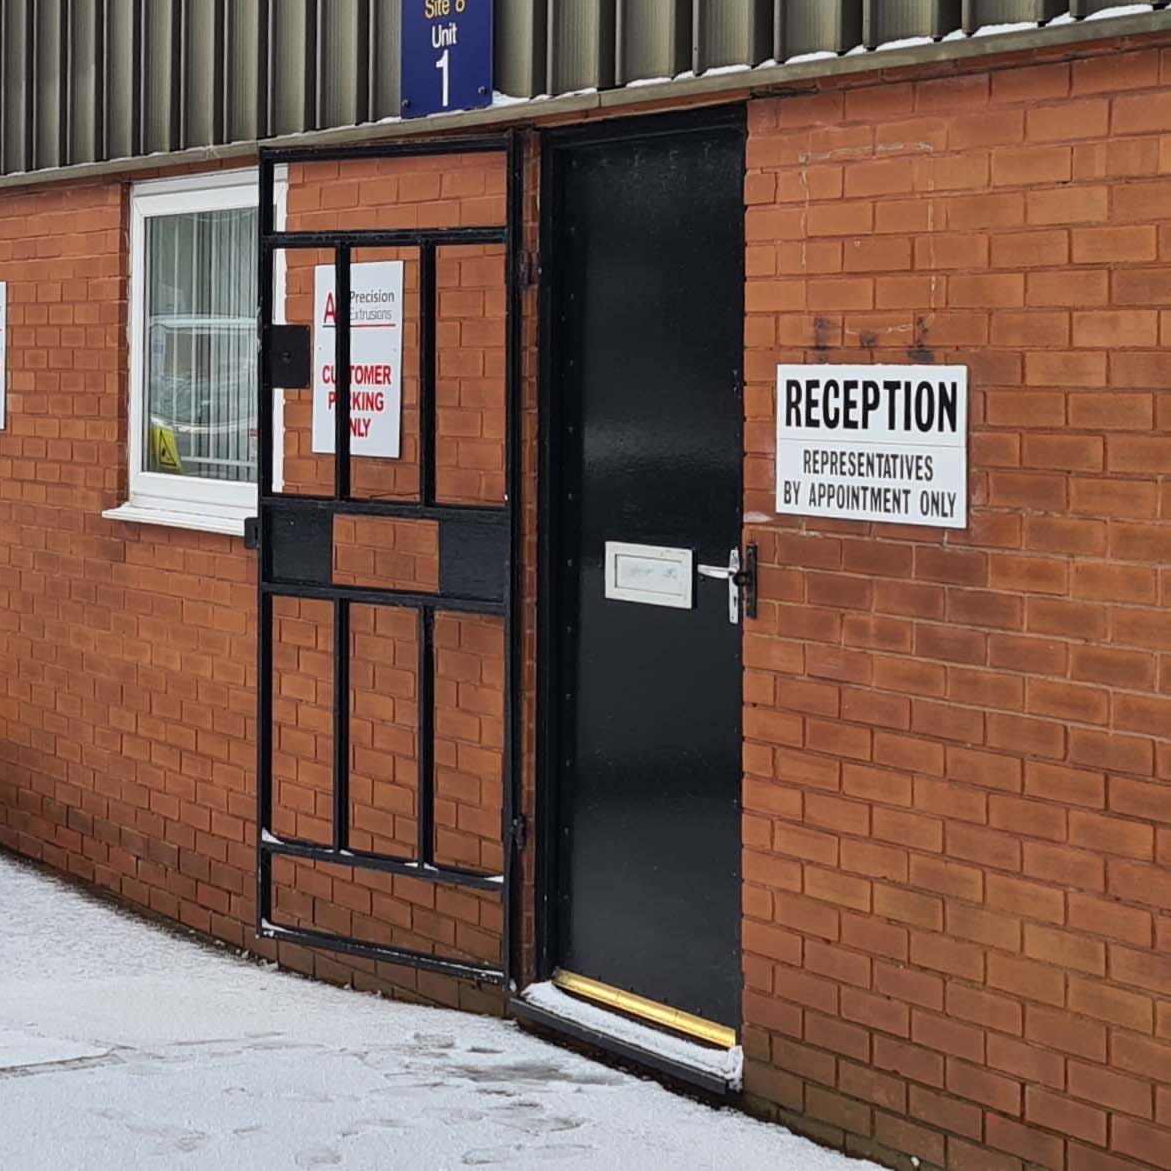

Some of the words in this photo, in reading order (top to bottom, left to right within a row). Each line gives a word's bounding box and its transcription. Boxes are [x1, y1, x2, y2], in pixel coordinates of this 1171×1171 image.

[432, 22, 458, 48] Unit
[435, 49, 450, 107] 1
[350, 289, 395, 303] Precision
[322, 365, 392, 385] CUTOMER
[328, 391, 384, 411] PKING
[785, 379, 958, 433] RECEPTION
[349, 418, 371, 438] NLY
[803, 449, 934, 482] REPRESENTATIVES
[783, 481, 801, 506] BY
[808, 483, 912, 515] APPOINTMENT
[919, 490, 957, 519] ONLY
